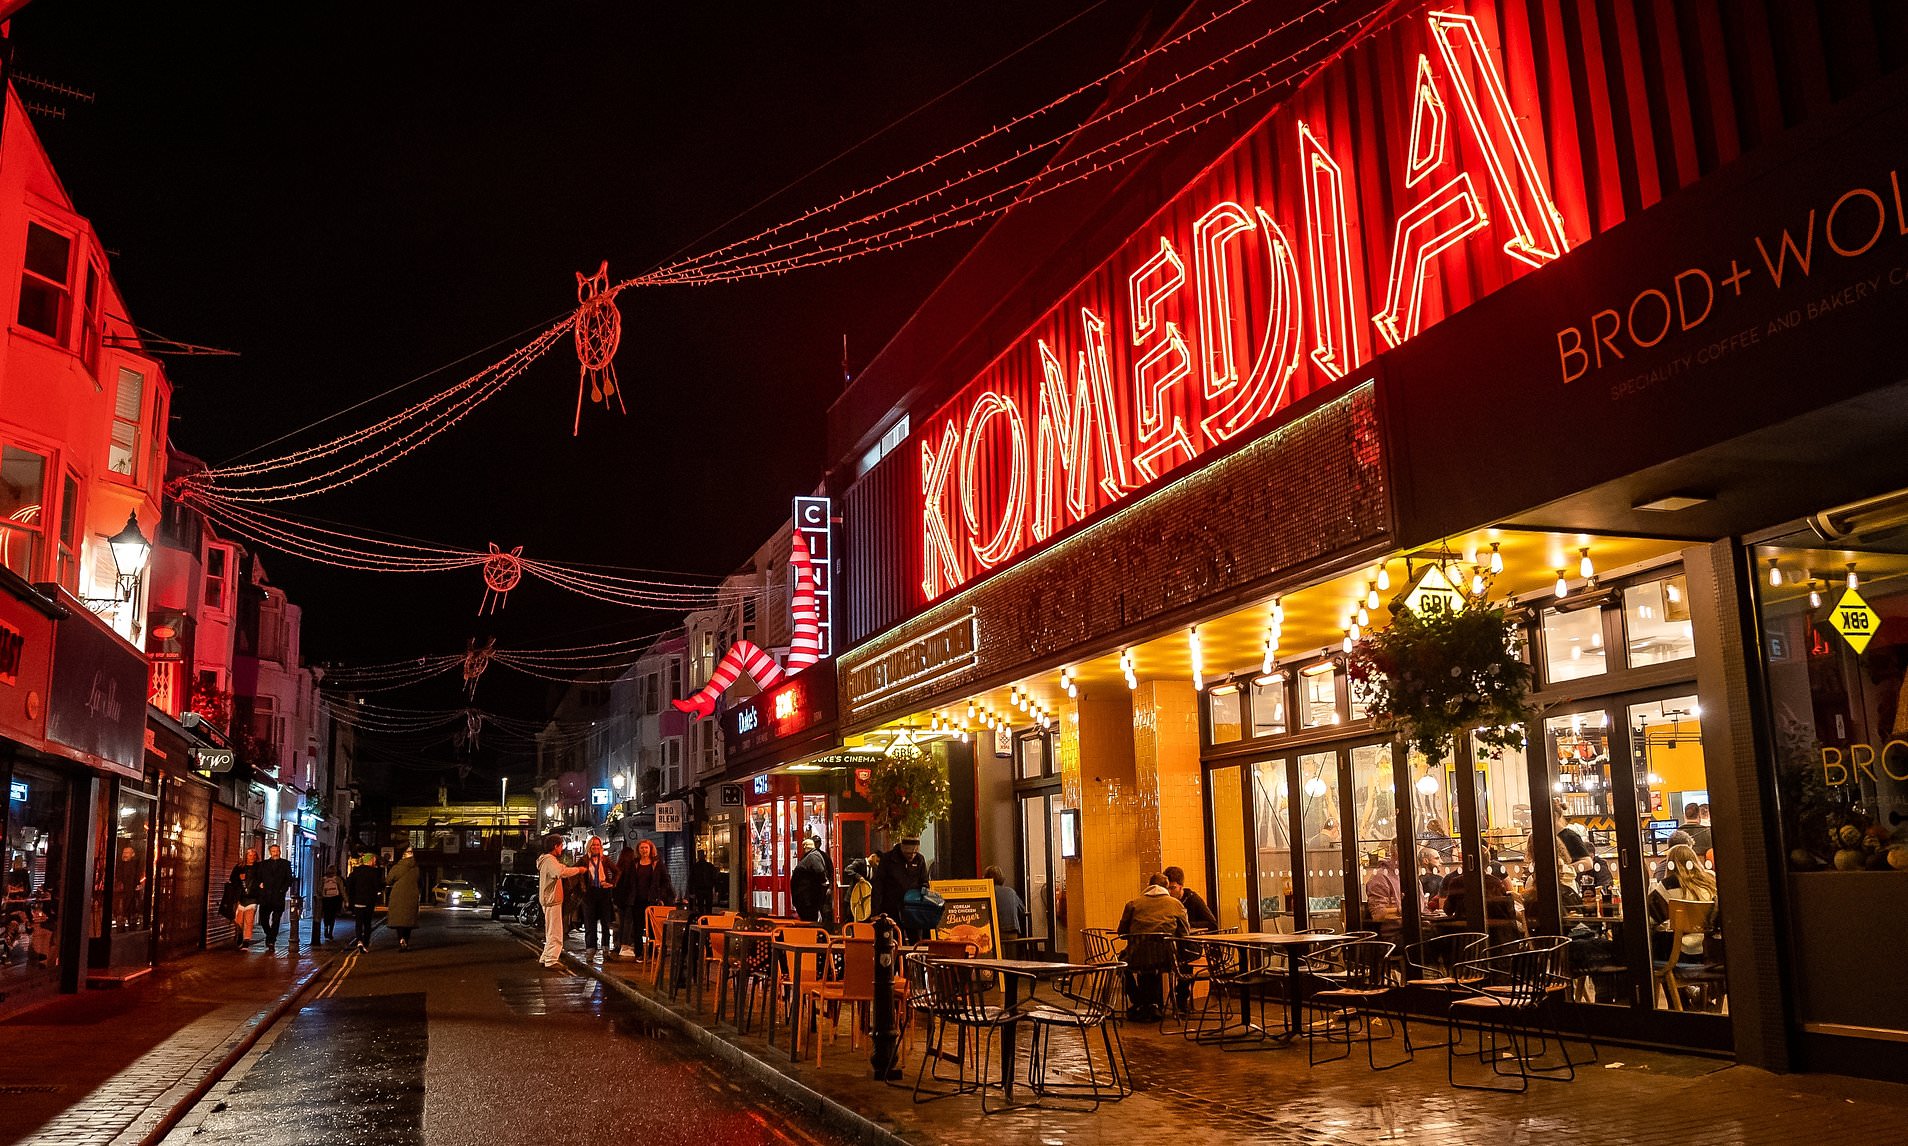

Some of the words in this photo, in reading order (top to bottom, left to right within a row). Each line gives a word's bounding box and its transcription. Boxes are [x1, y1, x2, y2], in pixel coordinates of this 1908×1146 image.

[921, 10, 1570, 601] KOMEDIA
[1610, 356, 1693, 402] SPECIALITY
[1697, 327, 1760, 365] COFFEE
[1767, 309, 1802, 337] AND
[1807, 277, 1881, 320] BAKERY
[739, 706, 758, 734] Duke's
[812, 755, 842, 763] UKE'S
[843, 755, 876, 763] CINEMA
[658, 806, 673, 814] BIRD
[658, 815, 679, 823] BLEND
[946, 913, 980, 924] Burger
